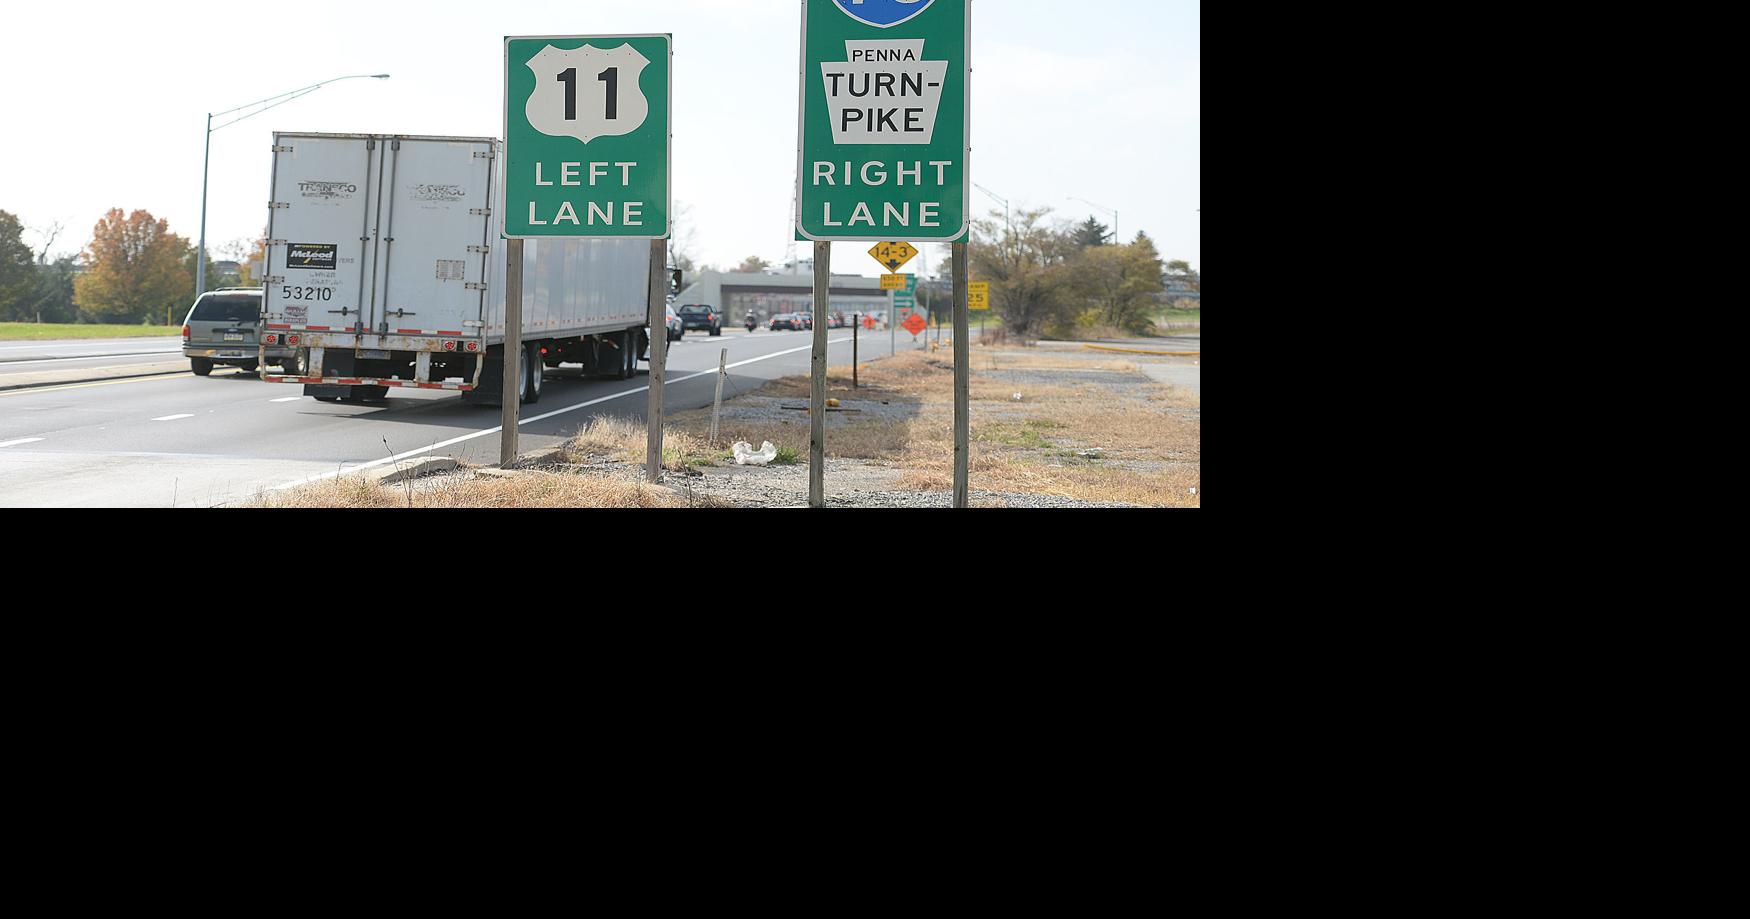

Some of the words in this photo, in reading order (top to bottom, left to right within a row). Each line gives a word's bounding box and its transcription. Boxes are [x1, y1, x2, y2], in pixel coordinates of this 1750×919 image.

[852, 49, 916, 62] PENNA
[556, 67, 618, 120] 11
[826, 71, 940, 98] TURN-
[840, 107, 925, 133] PIKE
[535, 161, 638, 186] LEFT
[812, 160, 953, 186] RIGHT
[528, 201, 644, 226] LANE
[822, 201, 941, 227] LANE
[290, 250, 334, 258] McLeod
[282, 286, 332, 301] 53210
[968, 293, 984, 302] 25
